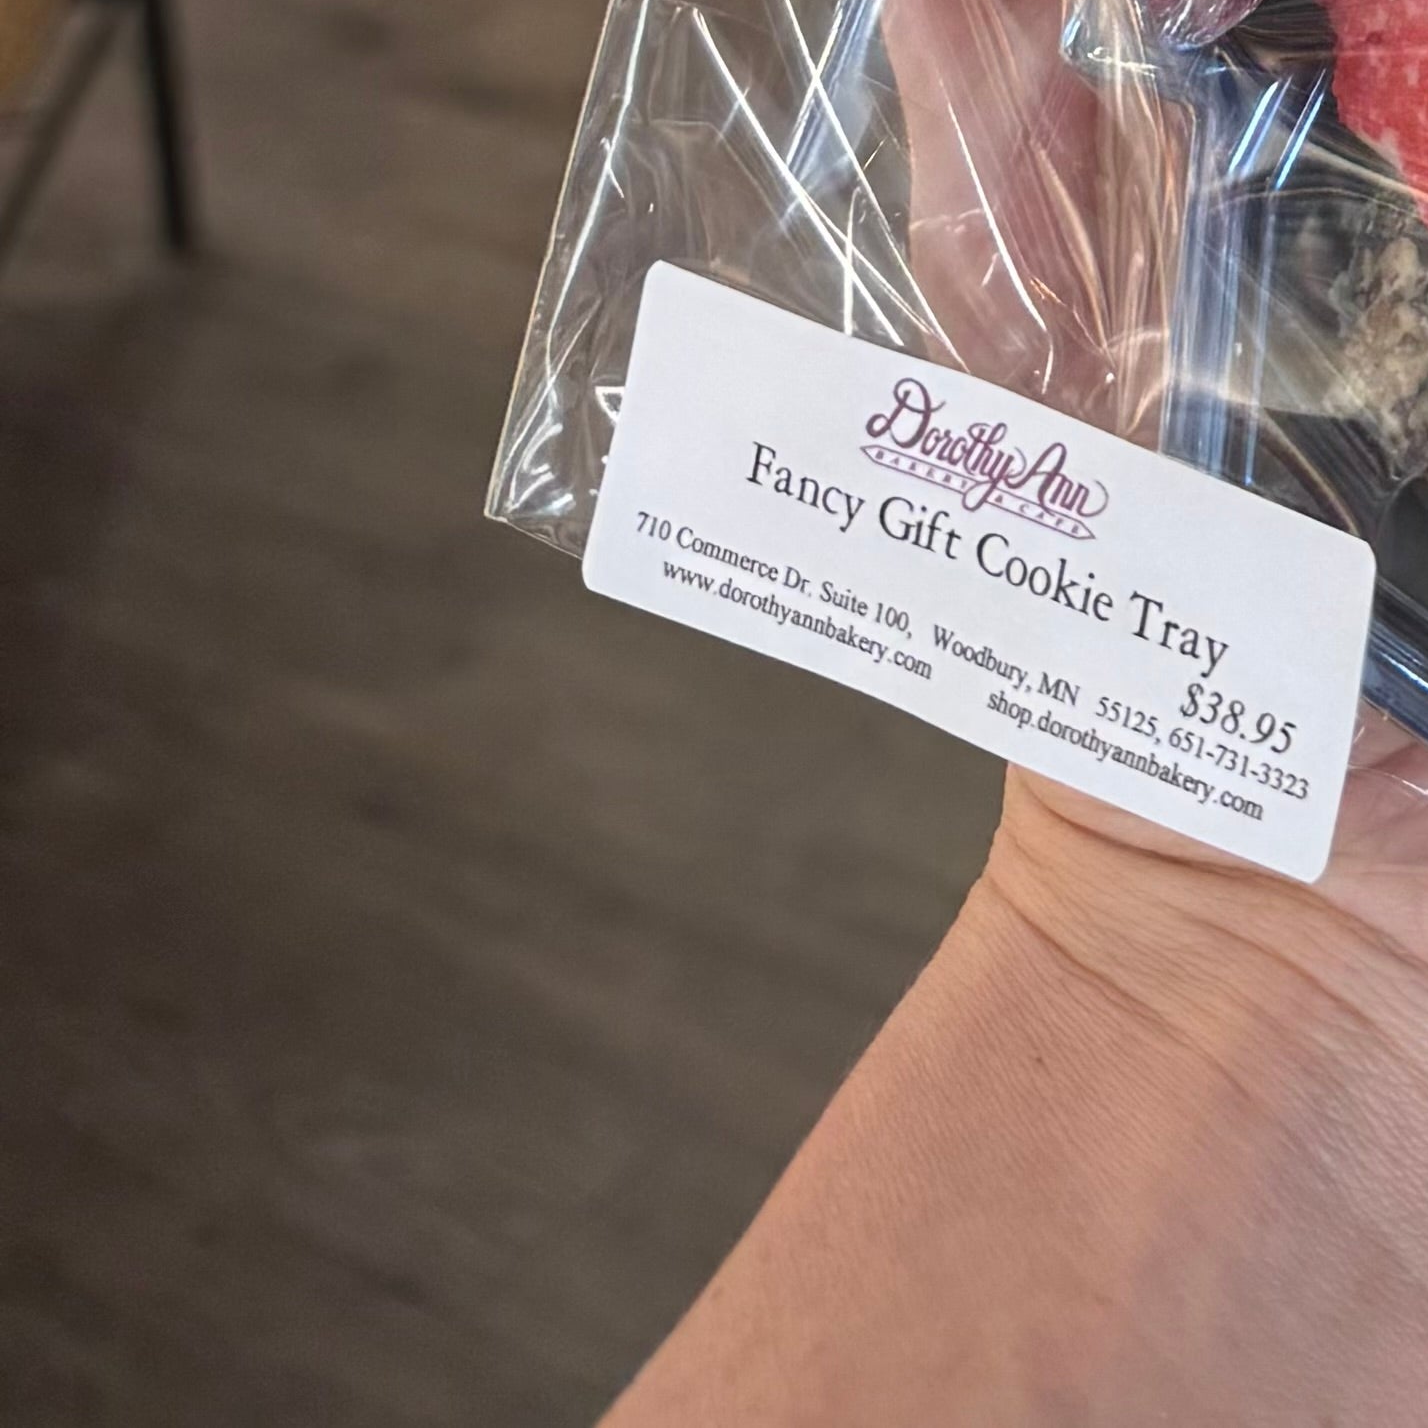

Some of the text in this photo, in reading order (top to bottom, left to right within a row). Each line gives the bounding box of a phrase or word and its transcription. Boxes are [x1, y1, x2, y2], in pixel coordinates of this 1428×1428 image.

[865, 377, 1109, 517] Dorothy Ann
[662, 561, 933, 680] www.dorothyannbakery.com
[746, 441, 1229, 679] Fancy Gift Cookie Tray
[637, 511, 1310, 800] 710 Commerce Dr. Suite 100, Woodbury, MN 55125, 651-731-3323
[1179, 683, 1298, 754] $38.95
[986, 691, 1264, 821] shop.dorothyannbakery.com
